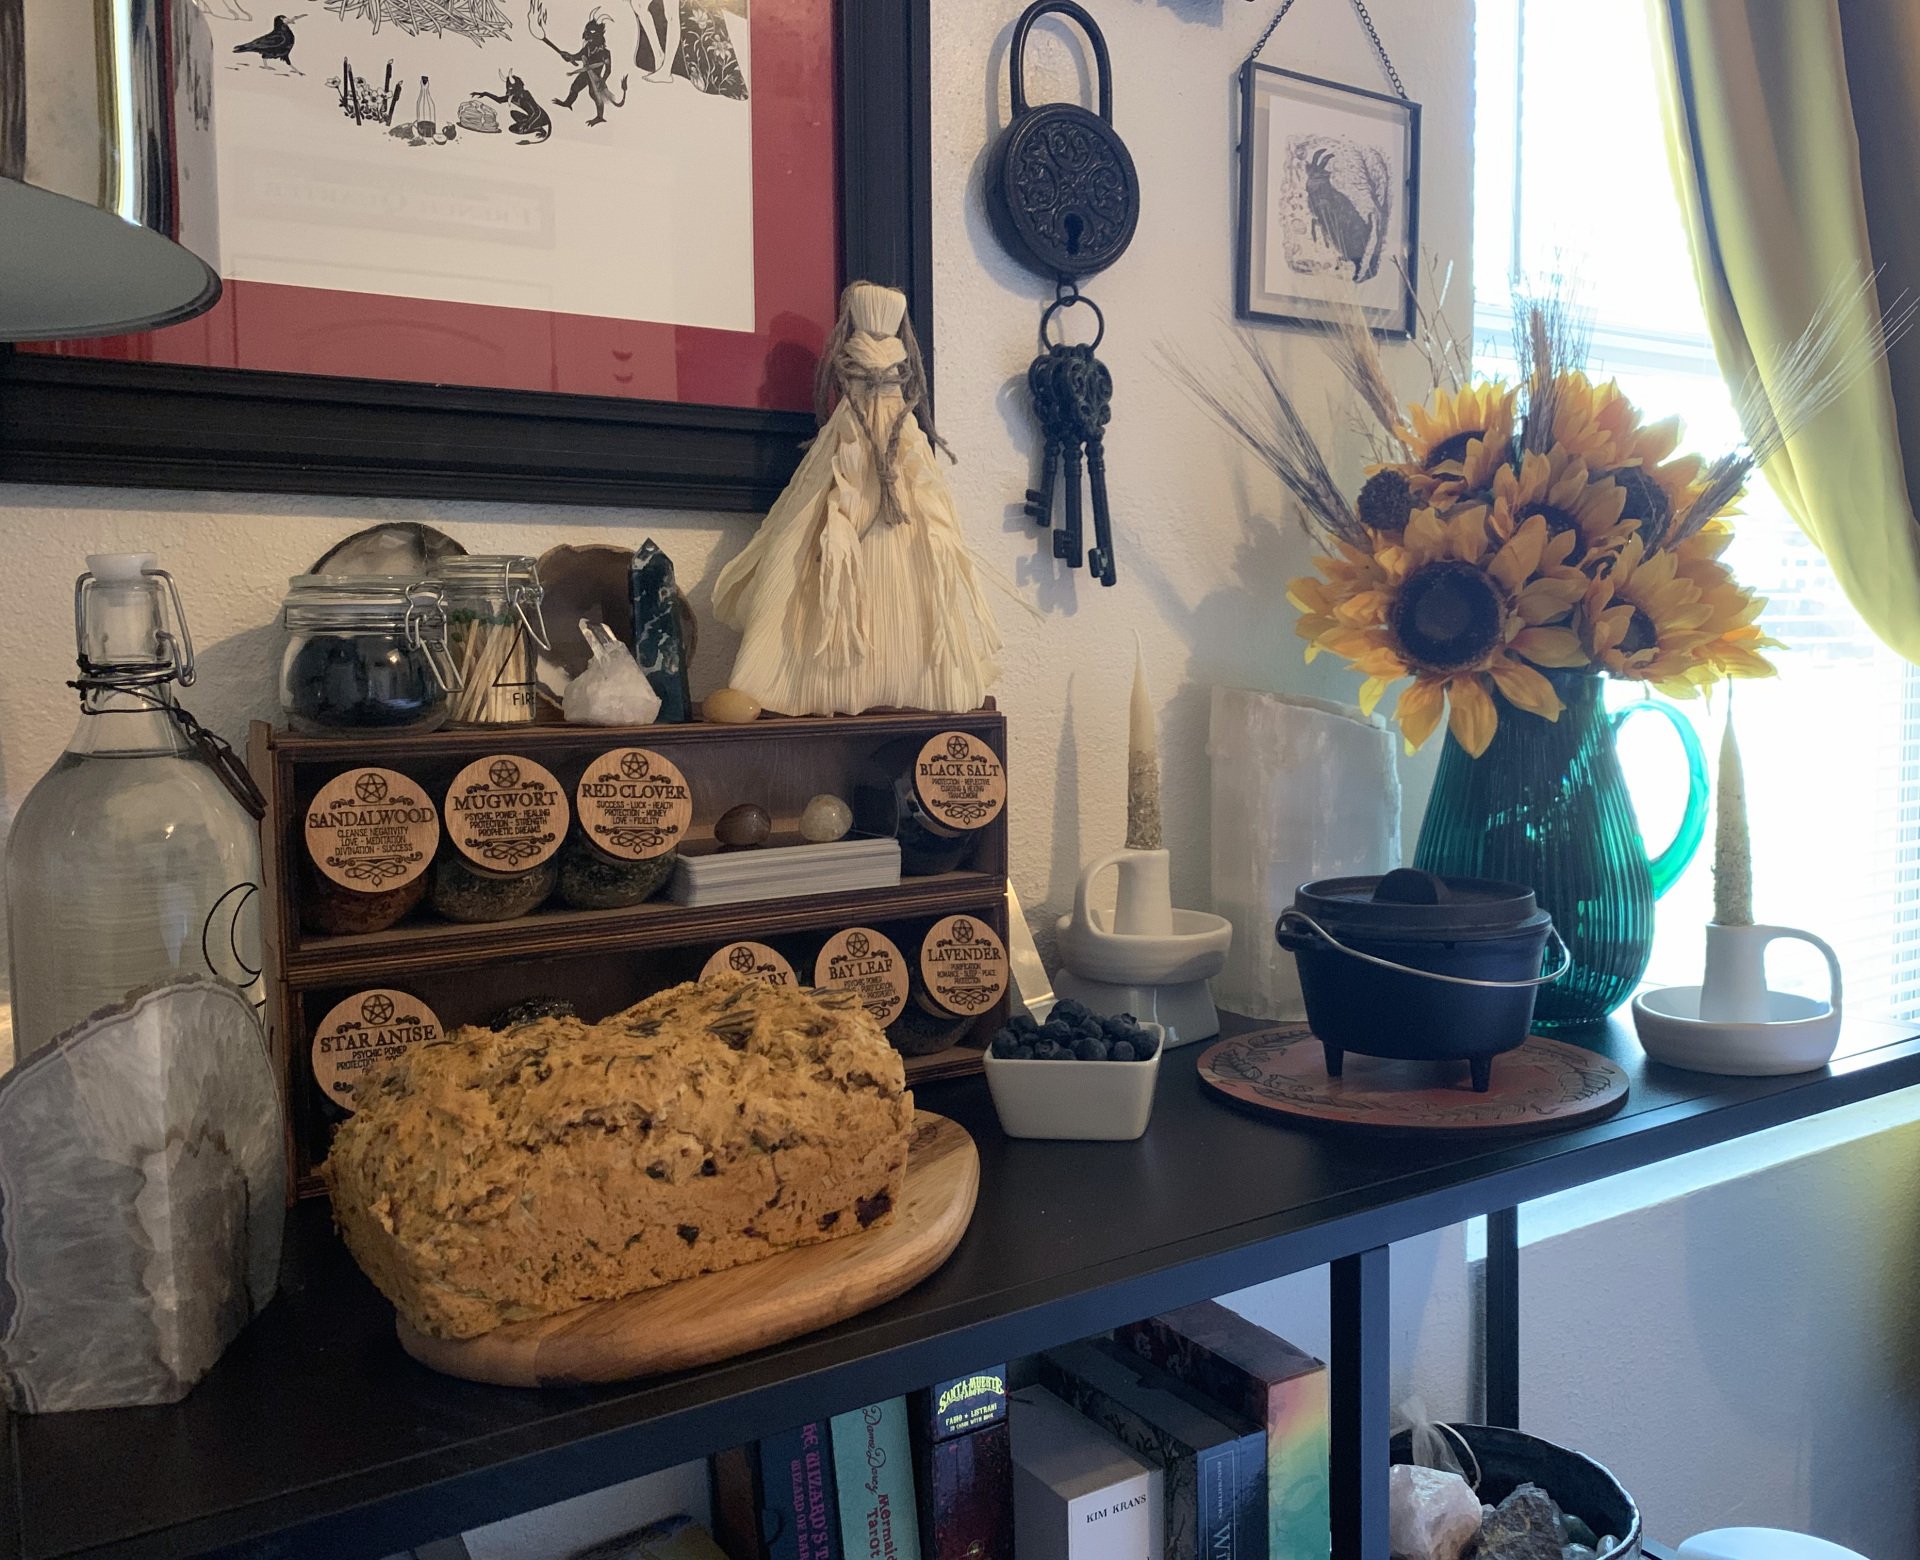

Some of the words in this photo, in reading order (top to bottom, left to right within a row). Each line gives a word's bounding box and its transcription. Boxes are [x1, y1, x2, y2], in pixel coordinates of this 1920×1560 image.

[919, 763, 965, 777] BLACK
[966, 764, 1000, 777] SALT
[581, 783, 618, 798] RED
[619, 784, 688, 799] CLOVER
[452, 791, 559, 811] MUGWORT
[596, 800, 625, 809] SUCCESS
[630, 801, 647, 809] LUCK
[652, 801, 674, 810] HEALTH
[308, 807, 435, 829] SANDALWOOD
[464, 811, 494, 821] PSYCHIC
[495, 810, 517, 820] POWER
[523, 808, 551, 818] HEALING
[604, 808, 640, 817] PROTECTION
[646, 809, 667, 817] MONEY
[469, 819, 509, 830] PROTECTION
[515, 817, 548, 828] STRENGTH
[612, 817, 627, 825] LOVE
[633, 817, 660, 825] FIDELITY
[336, 827, 368, 839] CLEANSE
[368, 826, 410, 837] NEGATIVITY
[478, 826, 515, 837] PROPHETIC
[515, 825, 542, 834] DREAMS
[341, 837, 358, 847] LOVE
[365, 835, 407, 846] MEDITATION
[334, 845, 375, 857] DIVINATION
[382, 843, 414, 853] SUCCESS
[927, 947, 1002, 962] LAVENDER
[828, 964, 855, 980] BAY
[857, 958, 893, 976] LEAF
[320, 1032, 373, 1053] STAR
[375, 1024, 437, 1047] ANISE
[352, 1048, 383, 1060] PSYCHIC
[937, 1380, 970, 1415] SANTA
[1086, 1507, 1108, 1524] KIM
[1112, 1493, 1147, 1515] KRANS
[866, 1507, 881, 1559] Tarot
